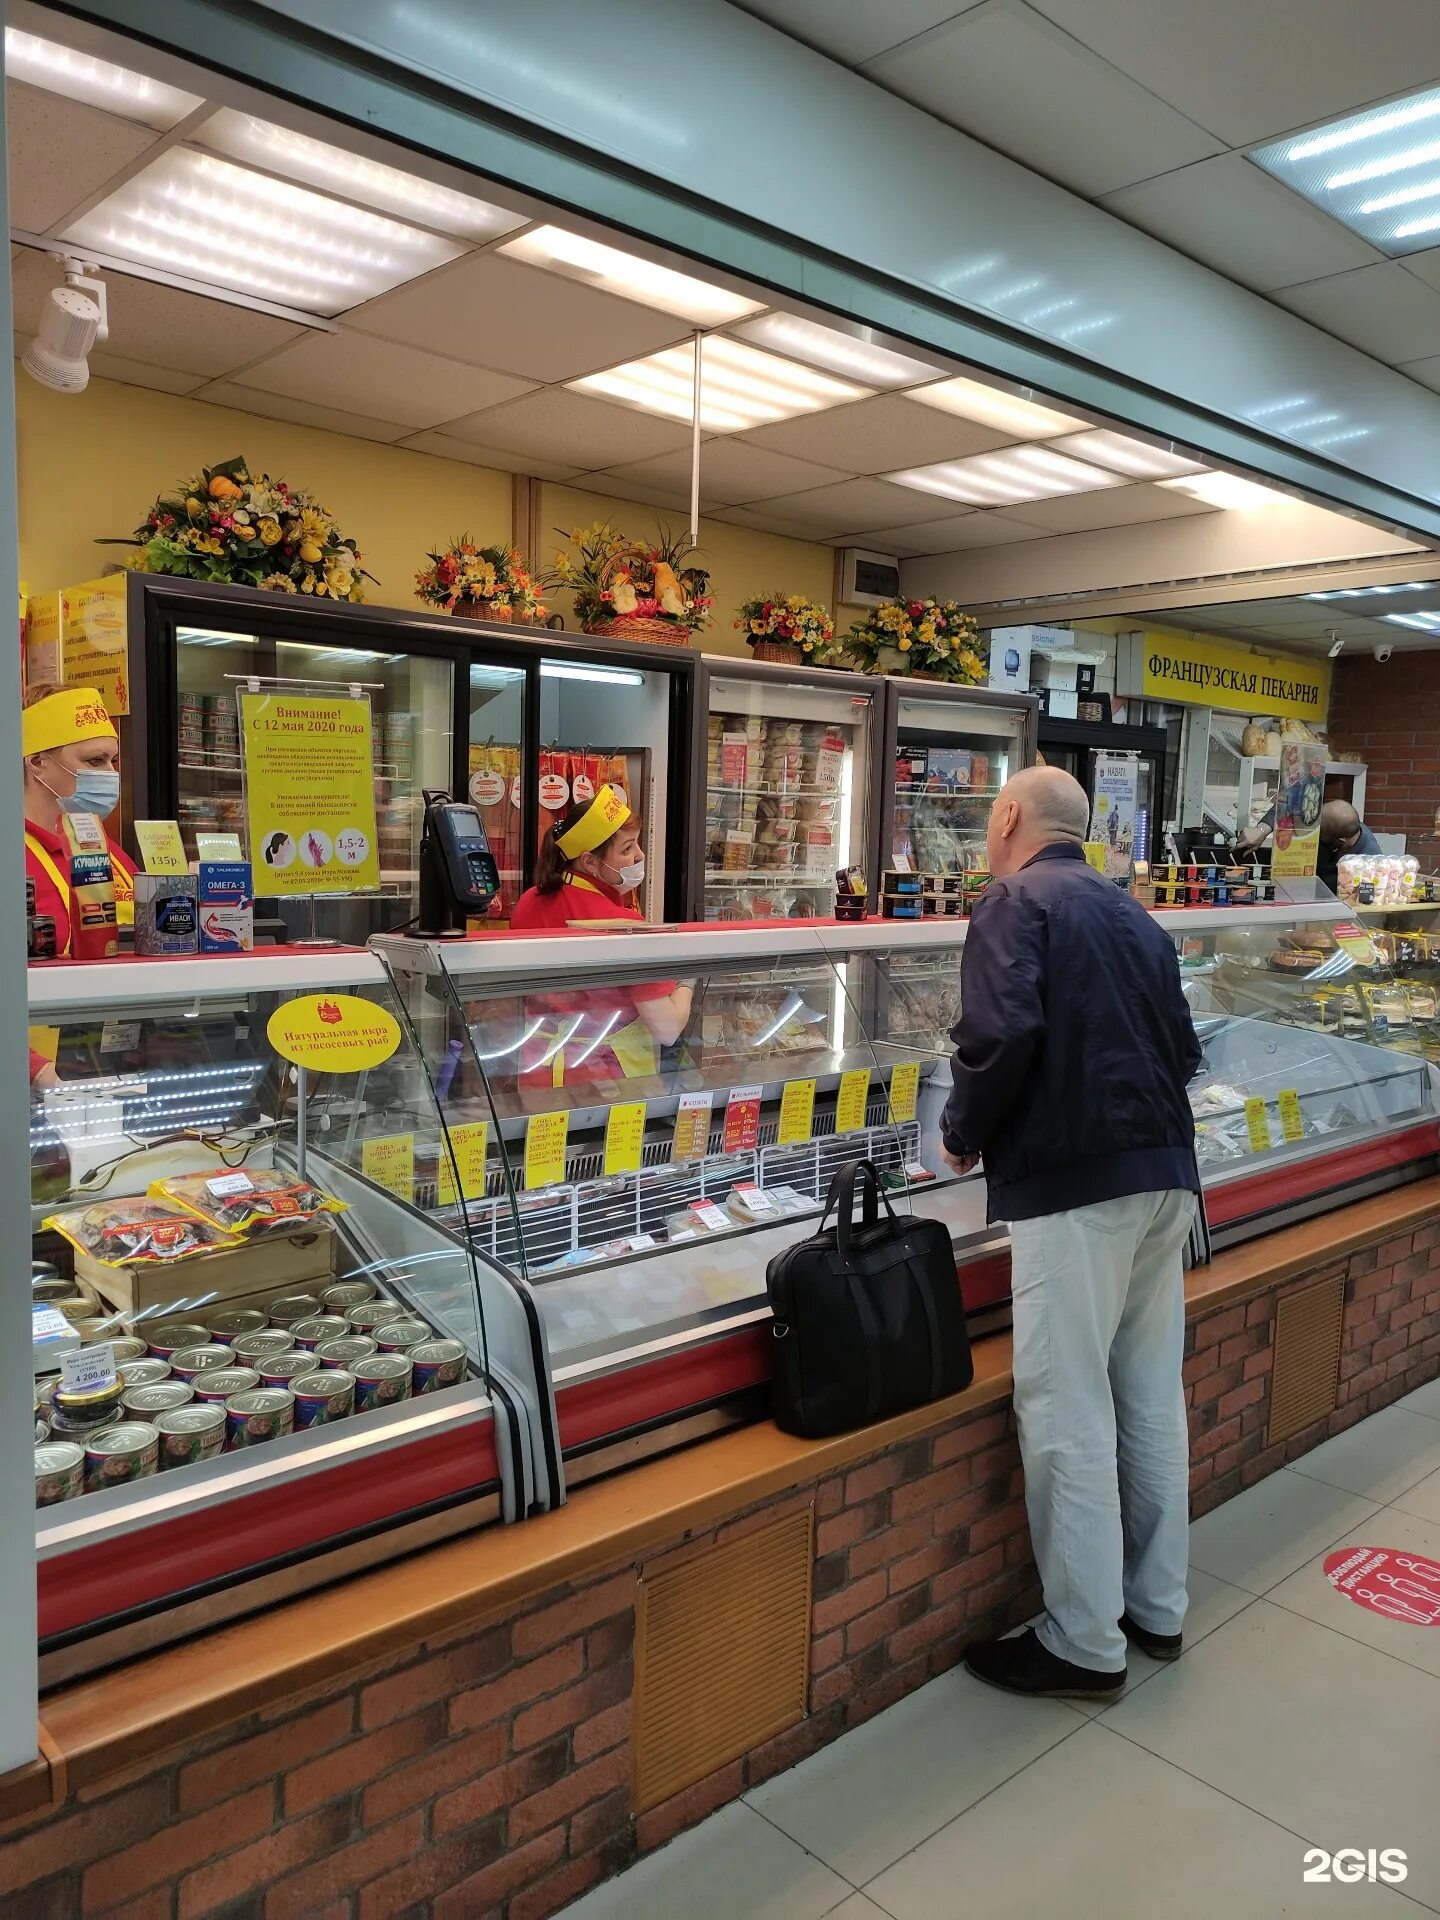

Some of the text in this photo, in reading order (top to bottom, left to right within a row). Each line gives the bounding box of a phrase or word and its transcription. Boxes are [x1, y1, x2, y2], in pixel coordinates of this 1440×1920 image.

[1148, 654, 1320, 705] ФРАНЦУЗСКАЯ ПЕКАРНЯ
[276, 706, 341, 720] Внимание!
[252, 719, 365, 736] С 12 мая 2020 года
[338, 838, 365, 850] 1,5-2
[150, 856, 181, 867] 135р.
[169, 914, 191, 922] ИВАСИ
[284, 1026, 388, 1042] Натуральная икра
[291, 1035, 389, 1052] из лососевых рыб
[277, 1201, 294, 1209] 300
[1340, 1553, 1389, 1590] ДИСТАНЦИЮ
